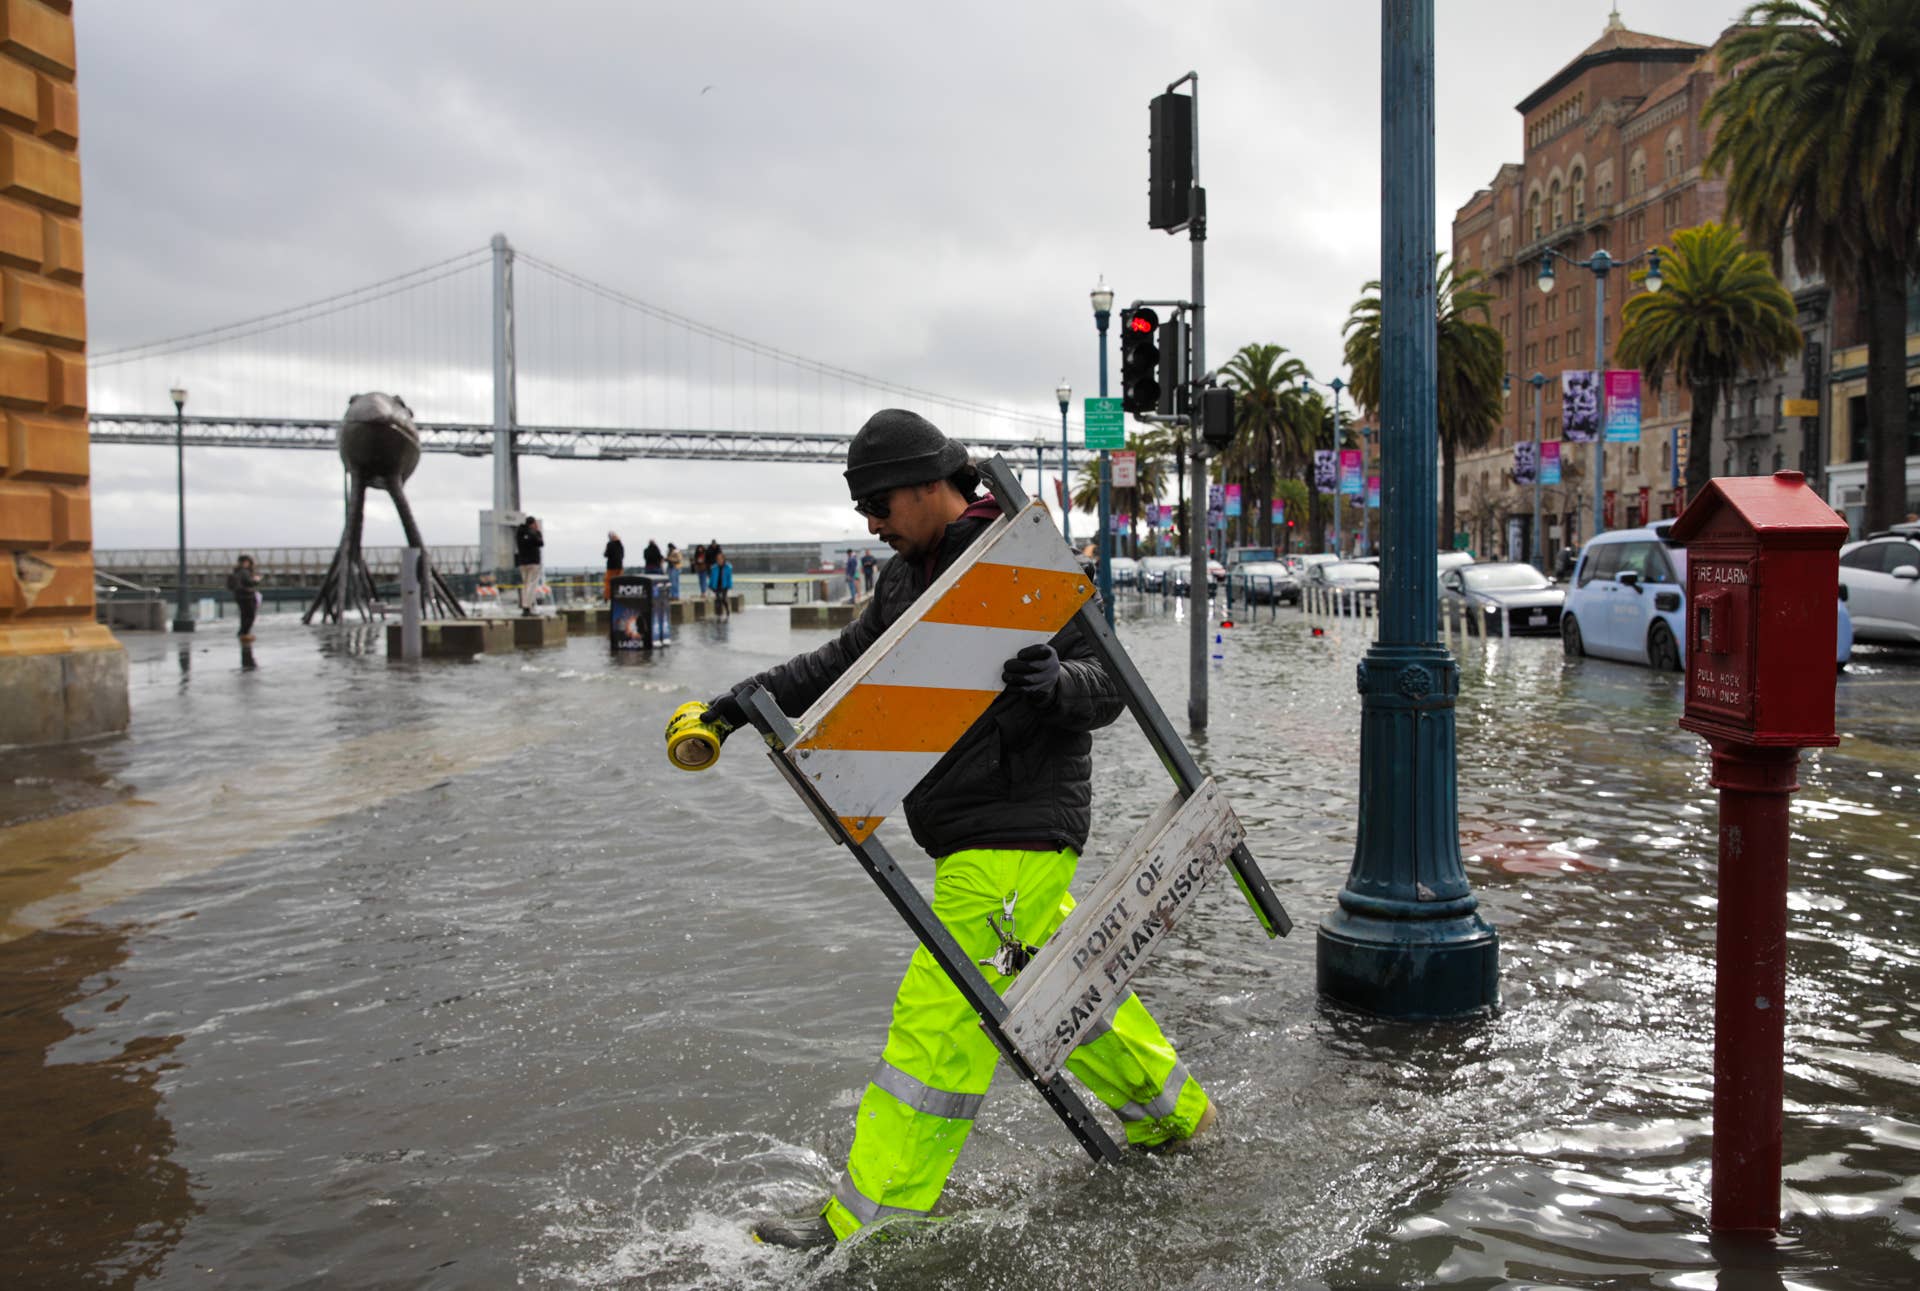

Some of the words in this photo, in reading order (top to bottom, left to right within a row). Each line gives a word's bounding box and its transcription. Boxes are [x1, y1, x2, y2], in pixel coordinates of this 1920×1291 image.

[1693, 566, 1713, 582] FIRE
[1714, 567, 1748, 584] ALARM
[619, 585, 643, 595] PORT
[1697, 668, 1715, 683] PULL
[1719, 672, 1740, 688] HOOK
[1719, 689, 1740, 705] ONCE
[1071, 896, 1132, 973] PORT
[1135, 854, 1165, 898] OF
[1055, 983, 1103, 1045] SAN
[1103, 842, 1218, 985] FRANCISCO
